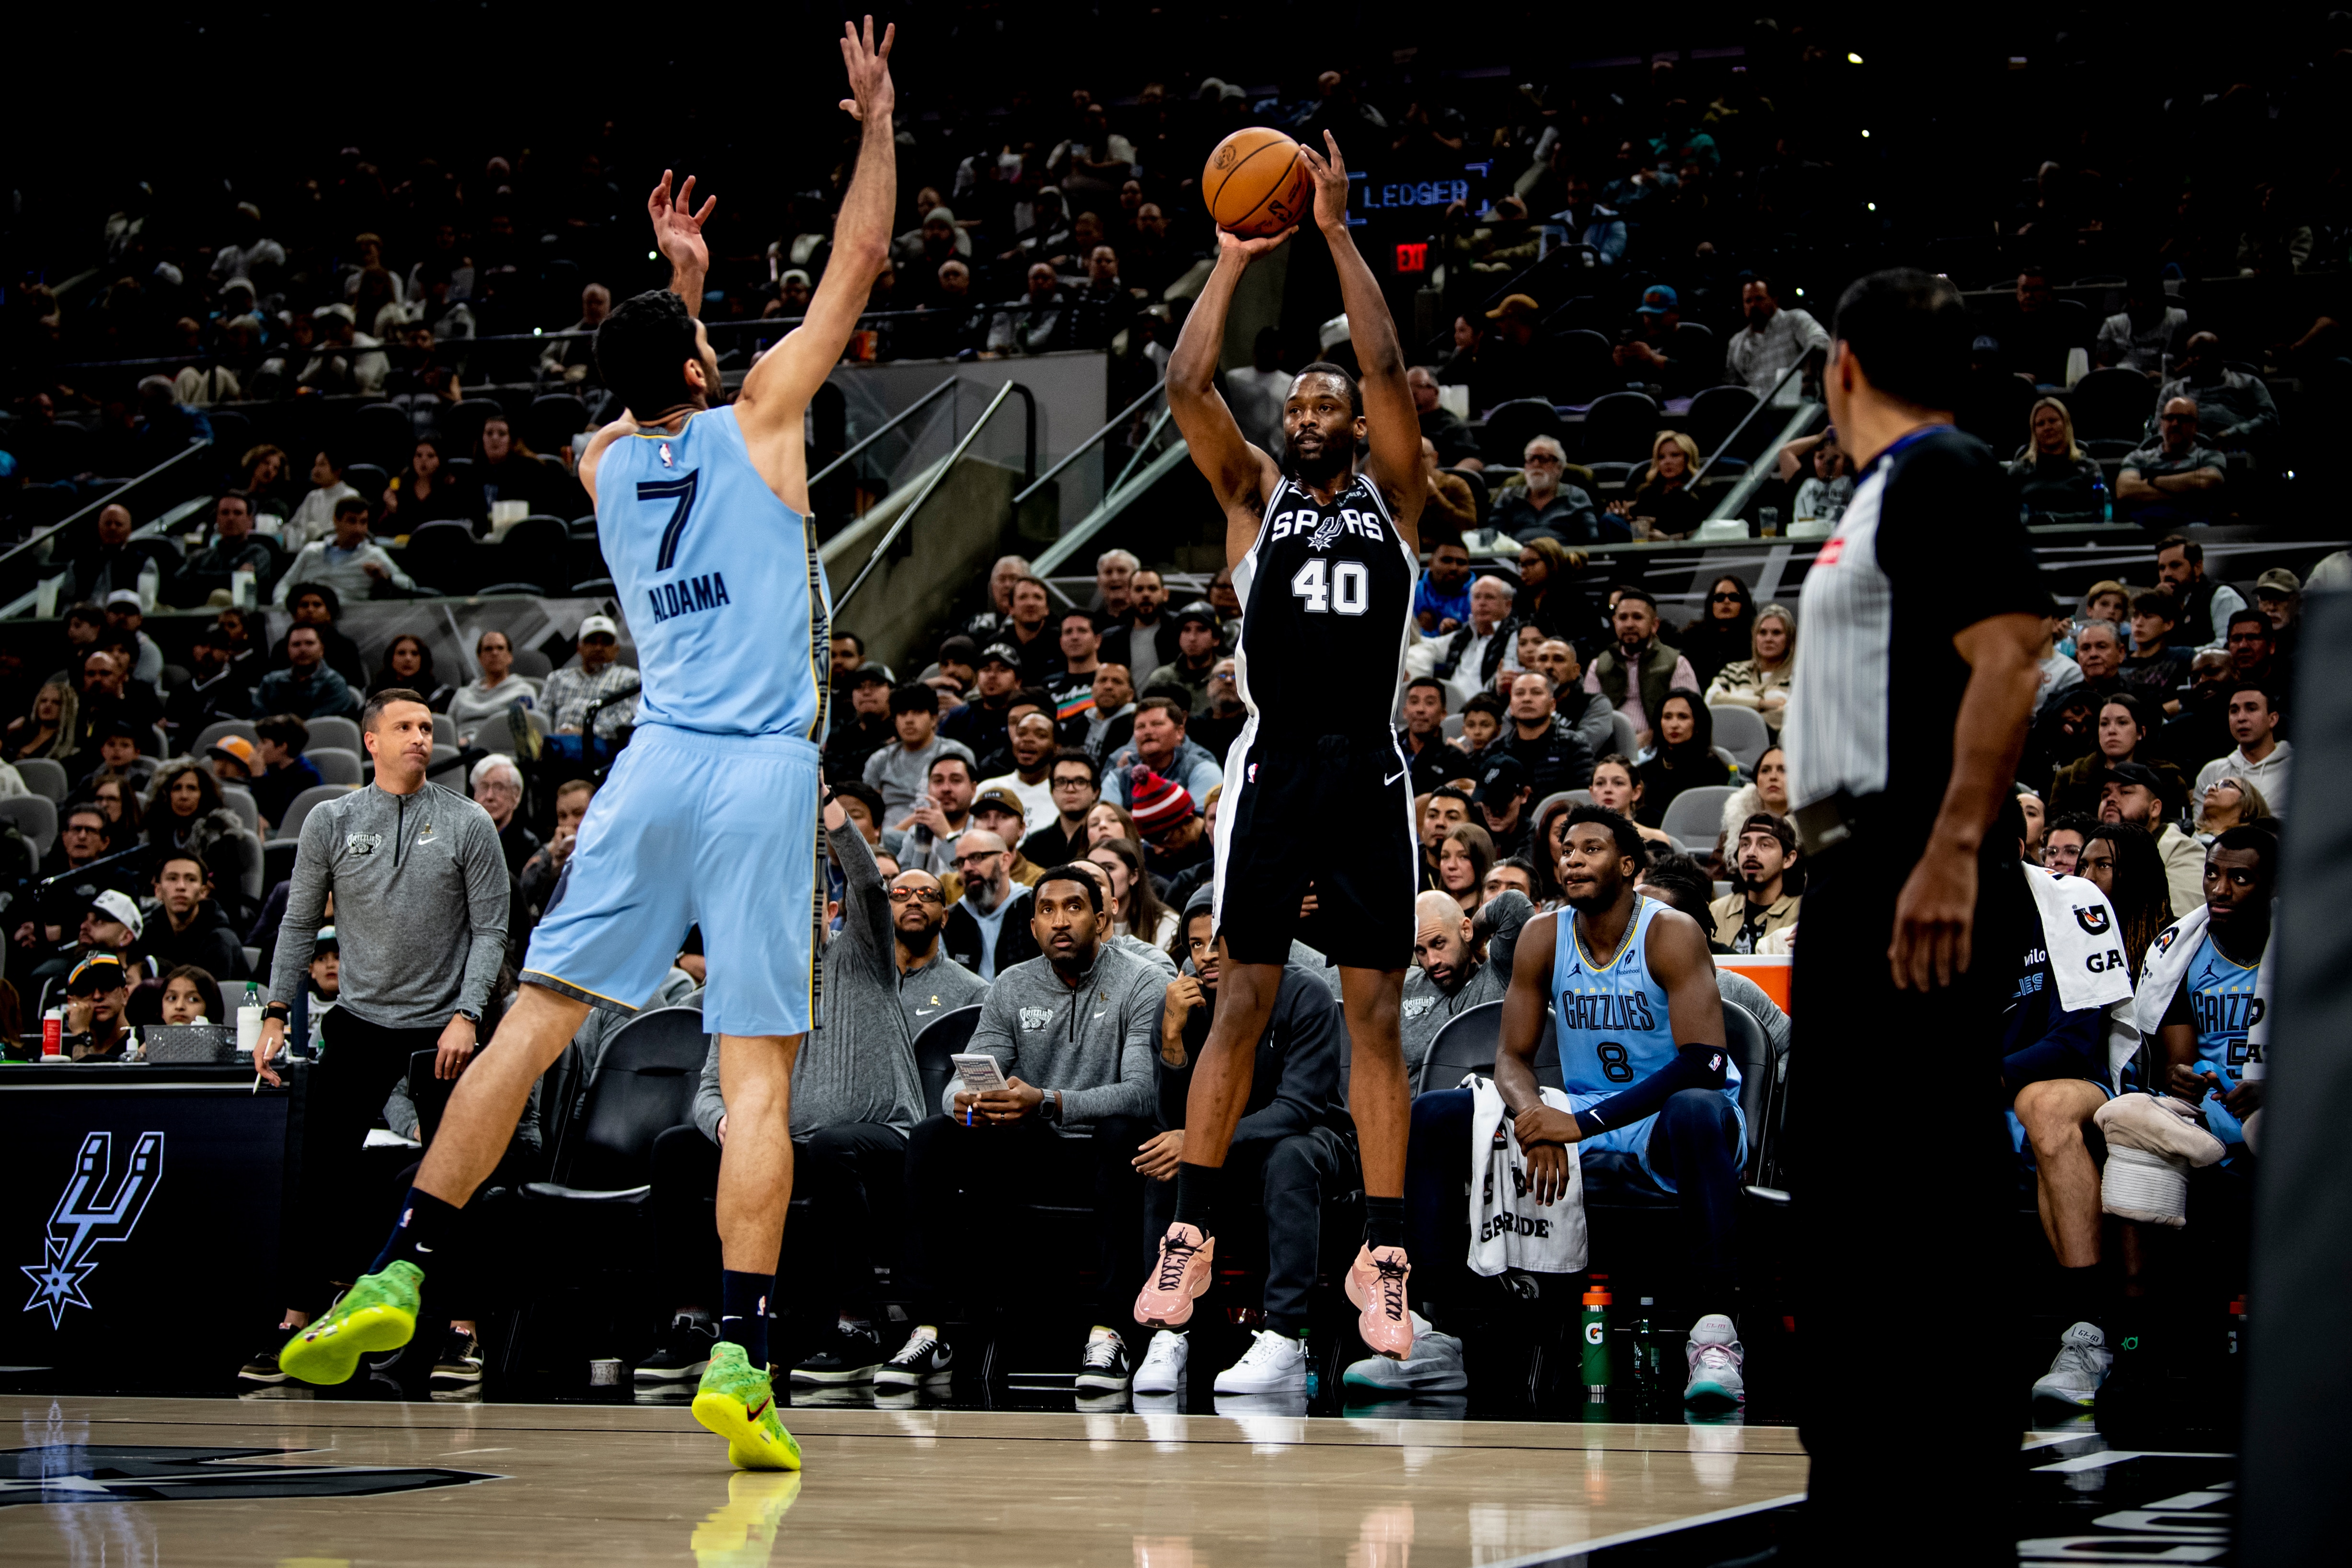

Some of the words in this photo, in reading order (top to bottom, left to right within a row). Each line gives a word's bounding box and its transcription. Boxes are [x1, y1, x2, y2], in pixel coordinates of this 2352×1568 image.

[1363, 179, 1470, 208] LEDGER
[637, 468, 699, 571] 7
[1271, 509, 1384, 552] SPURS
[648, 572, 730, 623] ALDAMA
[1291, 557, 1369, 616] 40
[1617, 967, 1640, 976] Robinhood
[1562, 990, 1655, 1031] GRZZLIES
[1597, 1042, 1634, 1083] 8
[1585, 1322, 1603, 1345] G
